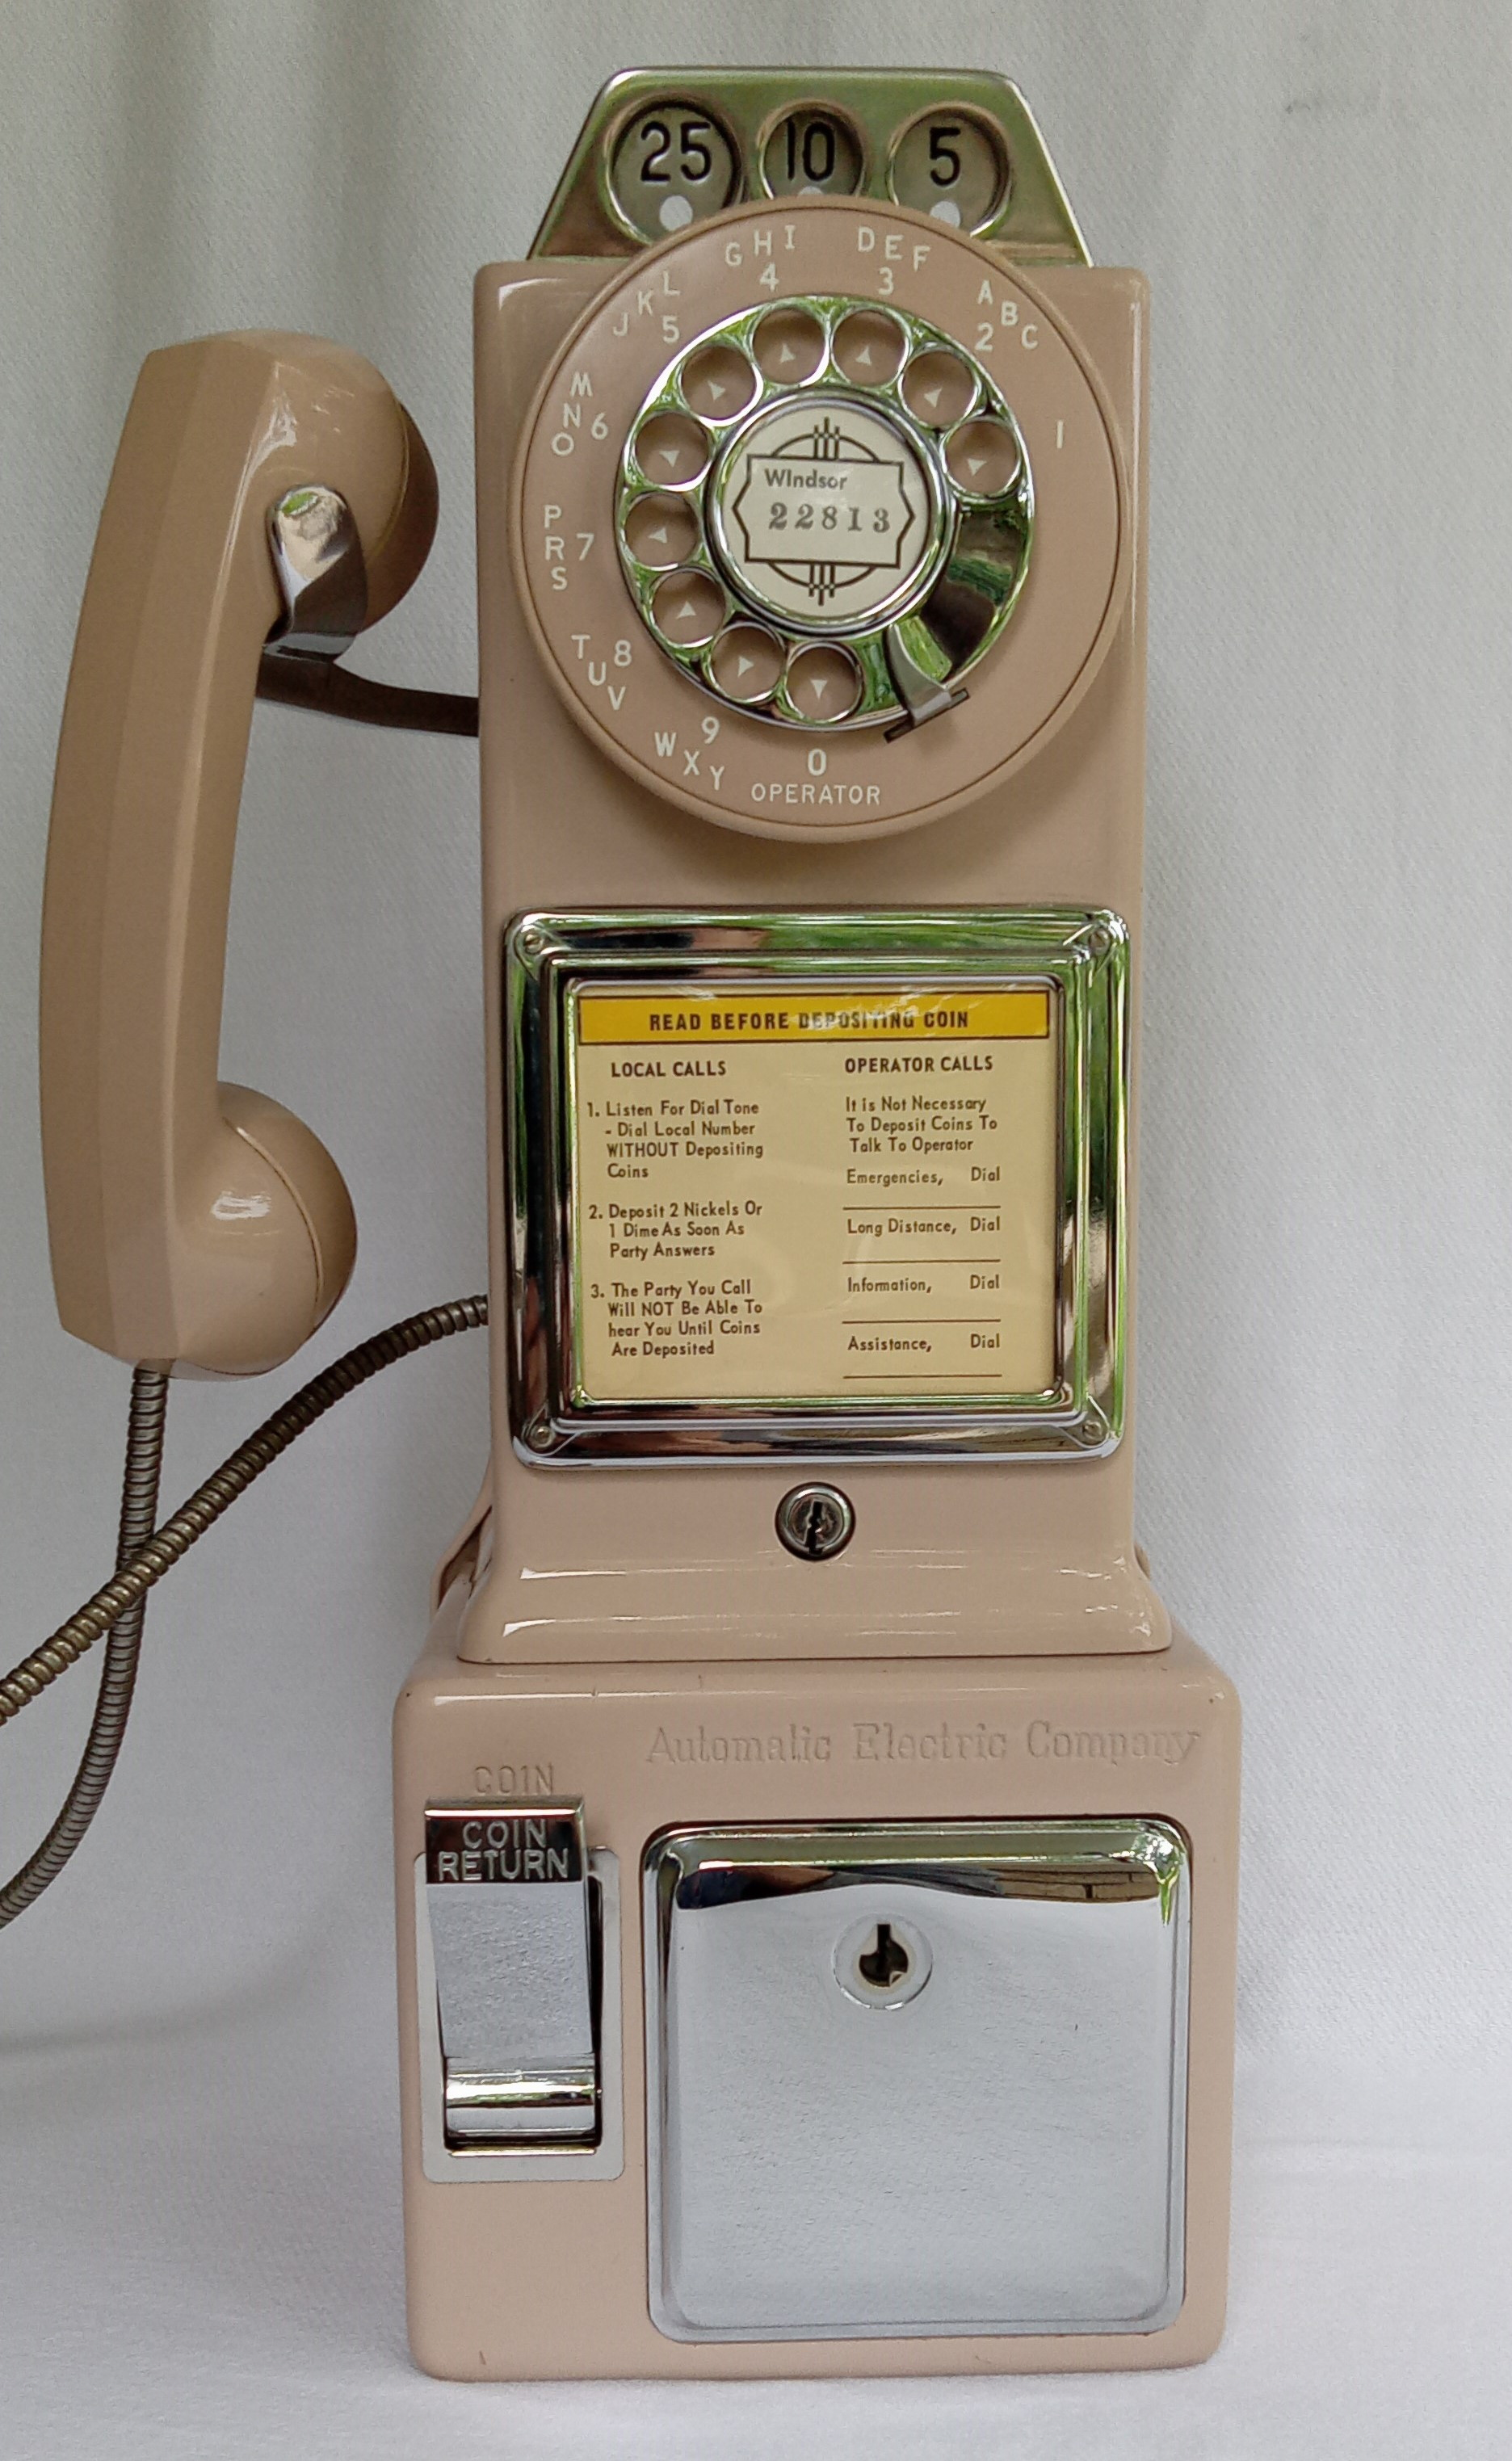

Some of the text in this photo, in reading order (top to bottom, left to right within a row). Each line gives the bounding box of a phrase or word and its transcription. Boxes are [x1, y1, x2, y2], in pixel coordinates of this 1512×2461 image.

[639, 120, 712, 184] 25
[786, 120, 835, 183] 10
[929, 125, 961, 187] 5
[758, 262, 779, 292] 4
[878, 267, 894, 296] 3
[662, 315, 680, 344] 5
[974, 322, 993, 351] 2
[591, 412, 608, 441] 6
[769, 502, 890, 533] 22813
[576, 533, 594, 561] 7
[614, 640, 632, 668] 8
[701, 716, 720, 745] 9
[750, 783, 881, 806] OPERATOR
[649, 1010, 968, 1031] READ BEFORE DEPOSITING COIN
[611, 1060, 726, 1077] LOCAL CALLS
[845, 1056, 993, 1073] OPERATOR CALLS
[587, 1098, 759, 1117] 1. Listen For Dial Tone
[846, 1096, 857, 1112] It
[881, 1096, 907, 1111] Not
[912, 1095, 986, 1113] Necessary
[618, 1121, 647, 1136] Dial
[654, 1120, 695, 1136] Local
[702, 1120, 755, 1136] Number
[846, 1115, 998, 1134] To Deposit Coins To
[607, 1140, 763, 1159] WITHOUT Depositing
[850, 1136, 973, 1155] Talk To Operator
[607, 1163, 649, 1178] Coins
[846, 1166, 1000, 1187] Emergencies, Dial
[588, 1200, 762, 1221] 2. Deposit 2 Nickels Or
[609, 1220, 745, 1238] 1 Dime As Soon As
[847, 1216, 1000, 1237] Long Distance, Dial
[610, 1241, 715, 1261] Party Answers
[590, 1279, 751, 1299] 3. The Party You Call
[848, 1275, 1000, 1294] Information, Dial
[607, 1299, 762, 1317] Will NOT Be Able To
[608, 1319, 761, 1338] hear You Until Coins
[611, 1340, 714, 1359] Are Deposited
[847, 1333, 1000, 1353] Assistance, Dial
[646, 1719, 1202, 1767] Automatic Electric Company
[473, 1762, 555, 1795] COIN
[462, 1818, 548, 1850] COIN
[438, 1847, 569, 1882] RETURN
